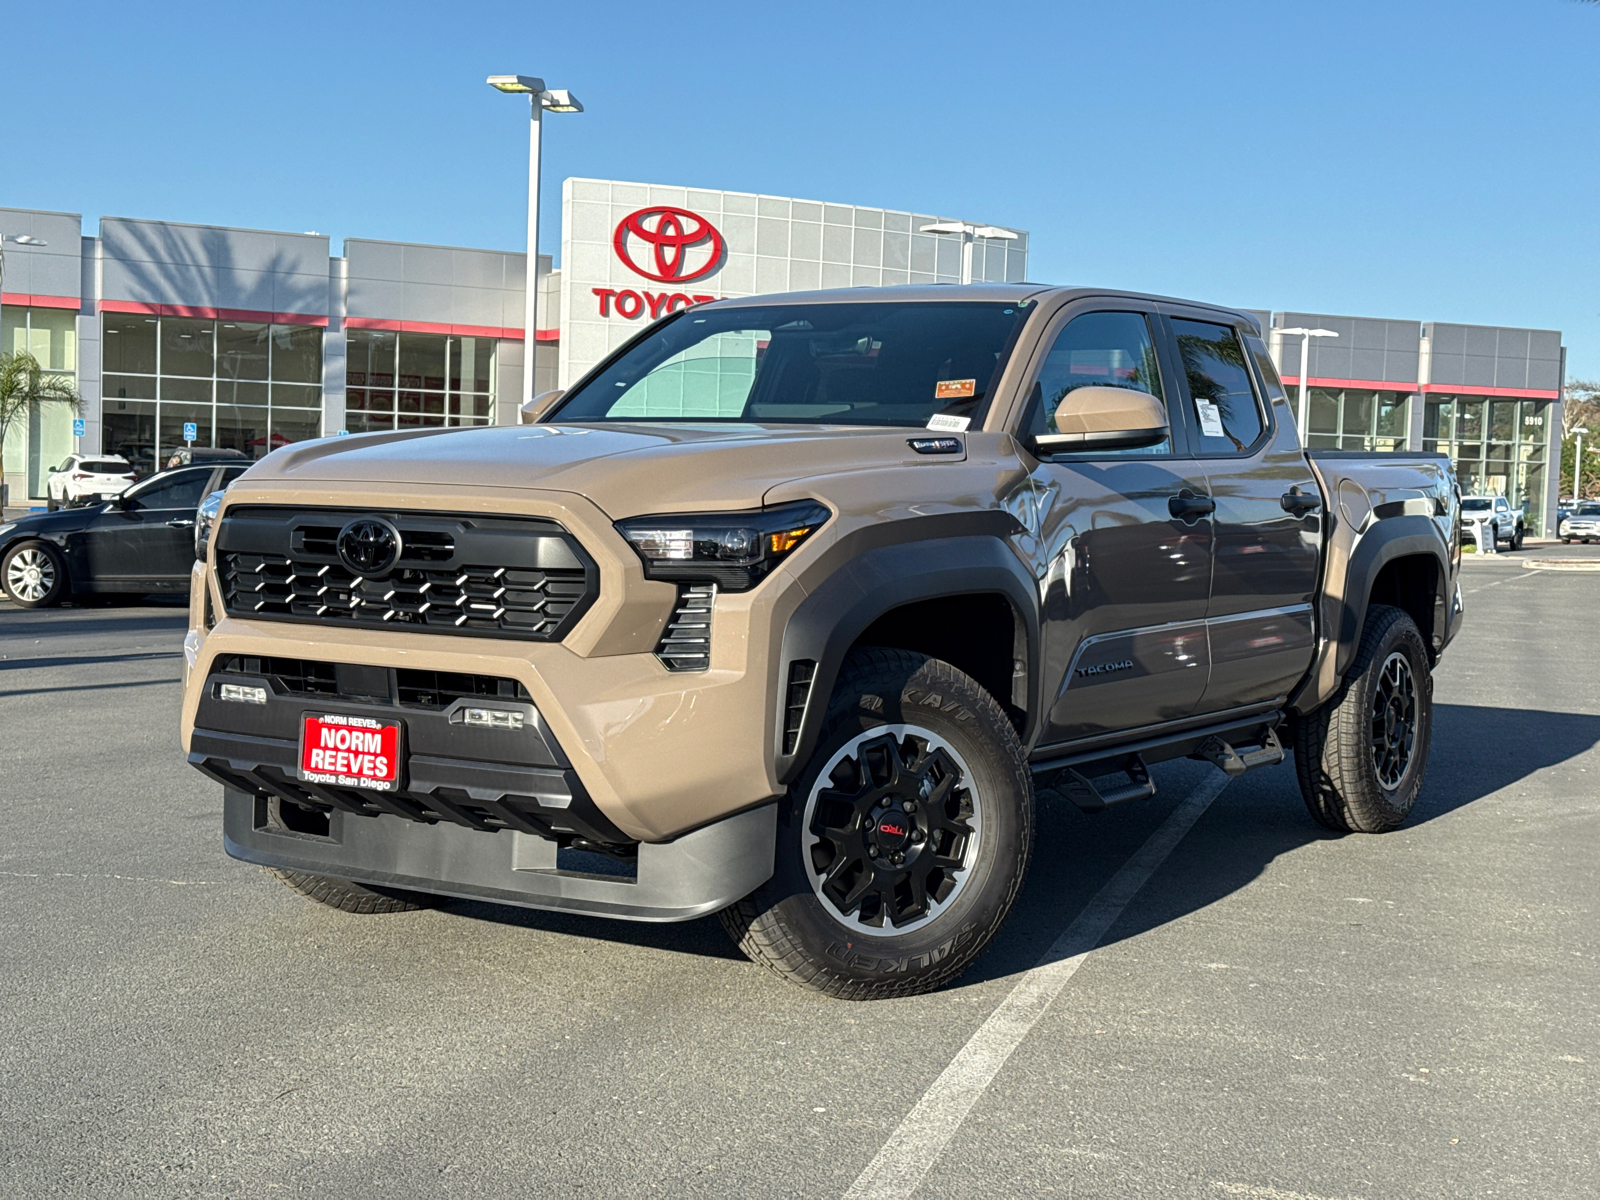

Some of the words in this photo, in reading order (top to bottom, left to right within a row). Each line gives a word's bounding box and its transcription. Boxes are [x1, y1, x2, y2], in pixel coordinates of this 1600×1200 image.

[592, 288, 714, 319] TOYO
[1525, 416, 1543, 426] 5910
[1076, 660, 1134, 676] TACOMA
[324, 715, 347, 726] NORM
[348, 717, 377, 729] REEVES
[320, 727, 382, 754] NORM
[310, 748, 388, 777] REEVES
[303, 770, 336, 784] Toyota
[338, 775, 358, 786] San
[360, 777, 391, 791] Diego
[880, 824, 904, 836] TRD
